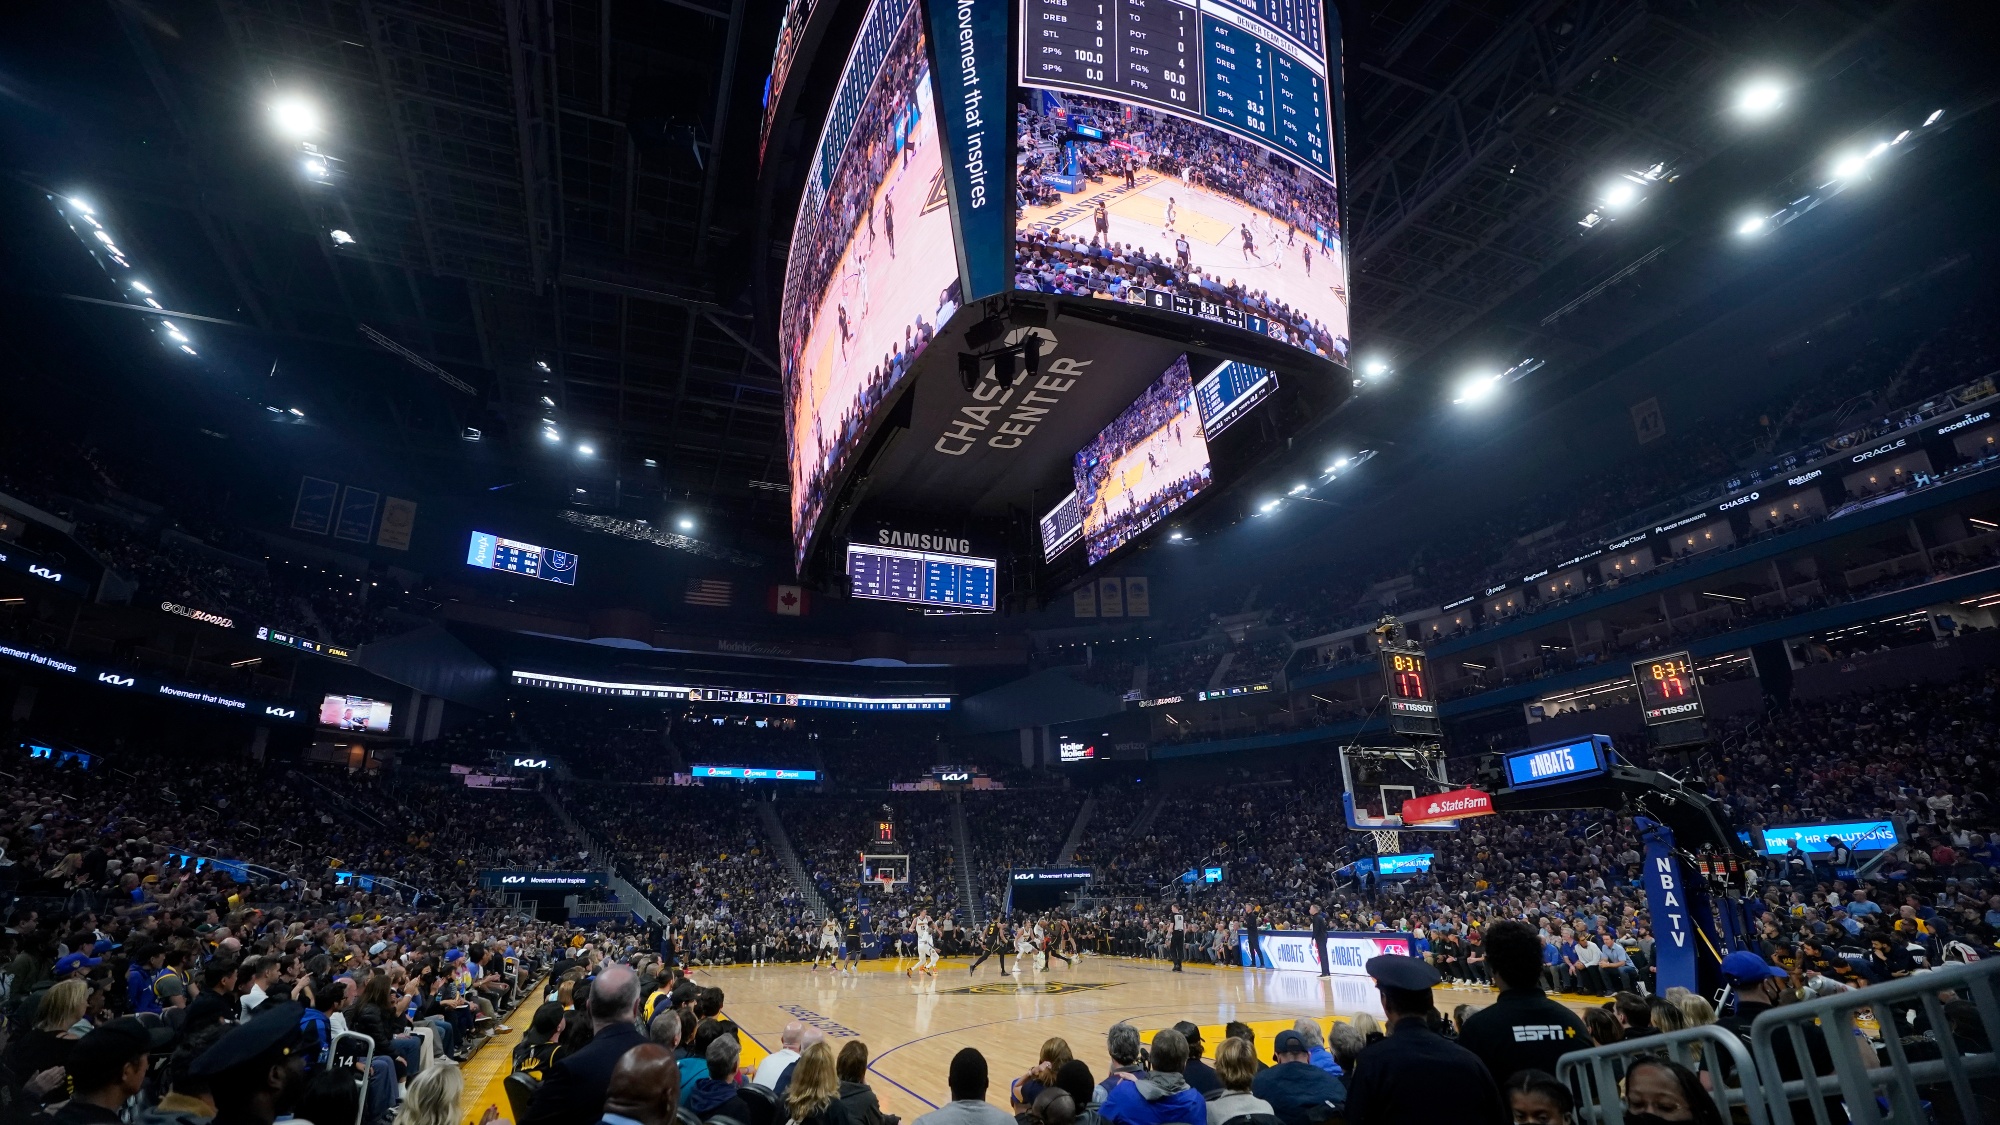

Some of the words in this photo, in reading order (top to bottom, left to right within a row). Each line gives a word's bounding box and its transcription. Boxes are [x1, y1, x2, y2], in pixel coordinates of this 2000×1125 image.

[1098, 4, 1103, 15] 1
[1178, 10, 1183, 21] 1
[1043, 13, 1067, 23] DREB
[1096, 20, 1103, 31] 3
[1129, 13, 1140, 22] TO
[1179, 26, 1184, 37] 1
[1043, 30, 1059, 38] STL
[1096, 36, 1103, 48] 0
[1129, 30, 1146, 40] POT
[1177, 42, 1184, 52] 0
[1215, 26, 1228, 36] AST
[1255, 42, 1261, 54] 2
[1237, 16, 1262, 36] DENVER
[1262, 27, 1280, 45] TEAM
[1280, 37, 1299, 56] STATS
[1042, 46, 1062, 56] 2P%
[1074, 49, 1103, 64] 100.0
[1130, 46, 1149, 56] PITP
[1178, 58, 1185, 69] 4
[1215, 42, 1235, 55] OREB
[1256, 58, 1262, 69] 2
[1216, 57, 1235, 70] DREB
[1042, 63, 1062, 73] 3P%
[1086, 68, 1103, 81] 0.0
[1130, 63, 1149, 73] FG%
[1163, 70, 1185, 85] 60.0
[1217, 73, 1230, 84] STL
[1279, 57, 1291, 69] BLK
[1312, 77, 1317, 88] 0
[1130, 79, 1148, 90] FT%
[1170, 88, 1186, 102] 0.0
[1280, 72, 1289, 82] TO
[1313, 92, 1318, 103] 0
[965, 89, 983, 129] that
[1217, 90, 1234, 101] 2P%
[1247, 100, 1265, 116] 33.3
[1281, 88, 1294, 100] POT
[1314, 107, 1319, 118] 0
[1218, 106, 1235, 118] 3P%
[1247, 115, 1265, 132] 50.0
[1282, 104, 1296, 116] PITP
[1315, 123, 1320, 133] 4
[1283, 119, 1298, 132] FG%
[1307, 131, 1322, 148] 37.5
[1284, 135, 1298, 147] FT%
[1311, 149, 1323, 164] 0.0
[967, 131, 986, 209] inspires
[1041, 175, 1072, 186] coinbase
[1155, 291, 1163, 306] 6
[1200, 301, 1220, 315] 8:31
[1254, 319, 1261, 331] 7
[988, 357, 1094, 449] CENTER
[1938, 412, 1990, 435] accenture
[1852, 439, 1907, 463] ORACLE
[1788, 469, 1822, 486] Rakuten
[1720, 495, 1750, 511] CHASE
[475, 535, 488, 564] xfinity
[878, 529, 970, 554] SAMSUNG
[1609, 540, 1630, 550] Google
[1629, 533, 1646, 543] Cloud
[1580, 550, 1602, 560] AIRLINES
[1492, 584, 1506, 594] pepsi
[274, 633, 287, 642] MIN
[30, 653, 48, 665] that
[47, 658, 77, 673] inspires
[329, 648, 348, 657] FINAL
[1394, 655, 1421, 672] 8:31
[1652, 660, 1686, 680] 8:31
[1402, 673, 1423, 698] 17
[1662, 678, 1684, 698] 17
[160, 686, 200, 700] Movement
[202, 694, 218, 703] that
[218, 696, 245, 709] inspires
[1405, 703, 1433, 712] TISSOT
[1660, 702, 1699, 716] TISSOT
[1530, 748, 1575, 777] #NBA75
[881, 830, 891, 839] 17
[1805, 835, 1821, 844] HR
[1656, 857, 1679, 907] NBA
[1668, 914, 1685, 948] TV
[1278, 943, 1304, 963] #NBA75
[1332, 945, 1362, 967] #NBA75
[339, 1055, 354, 1068] 14
